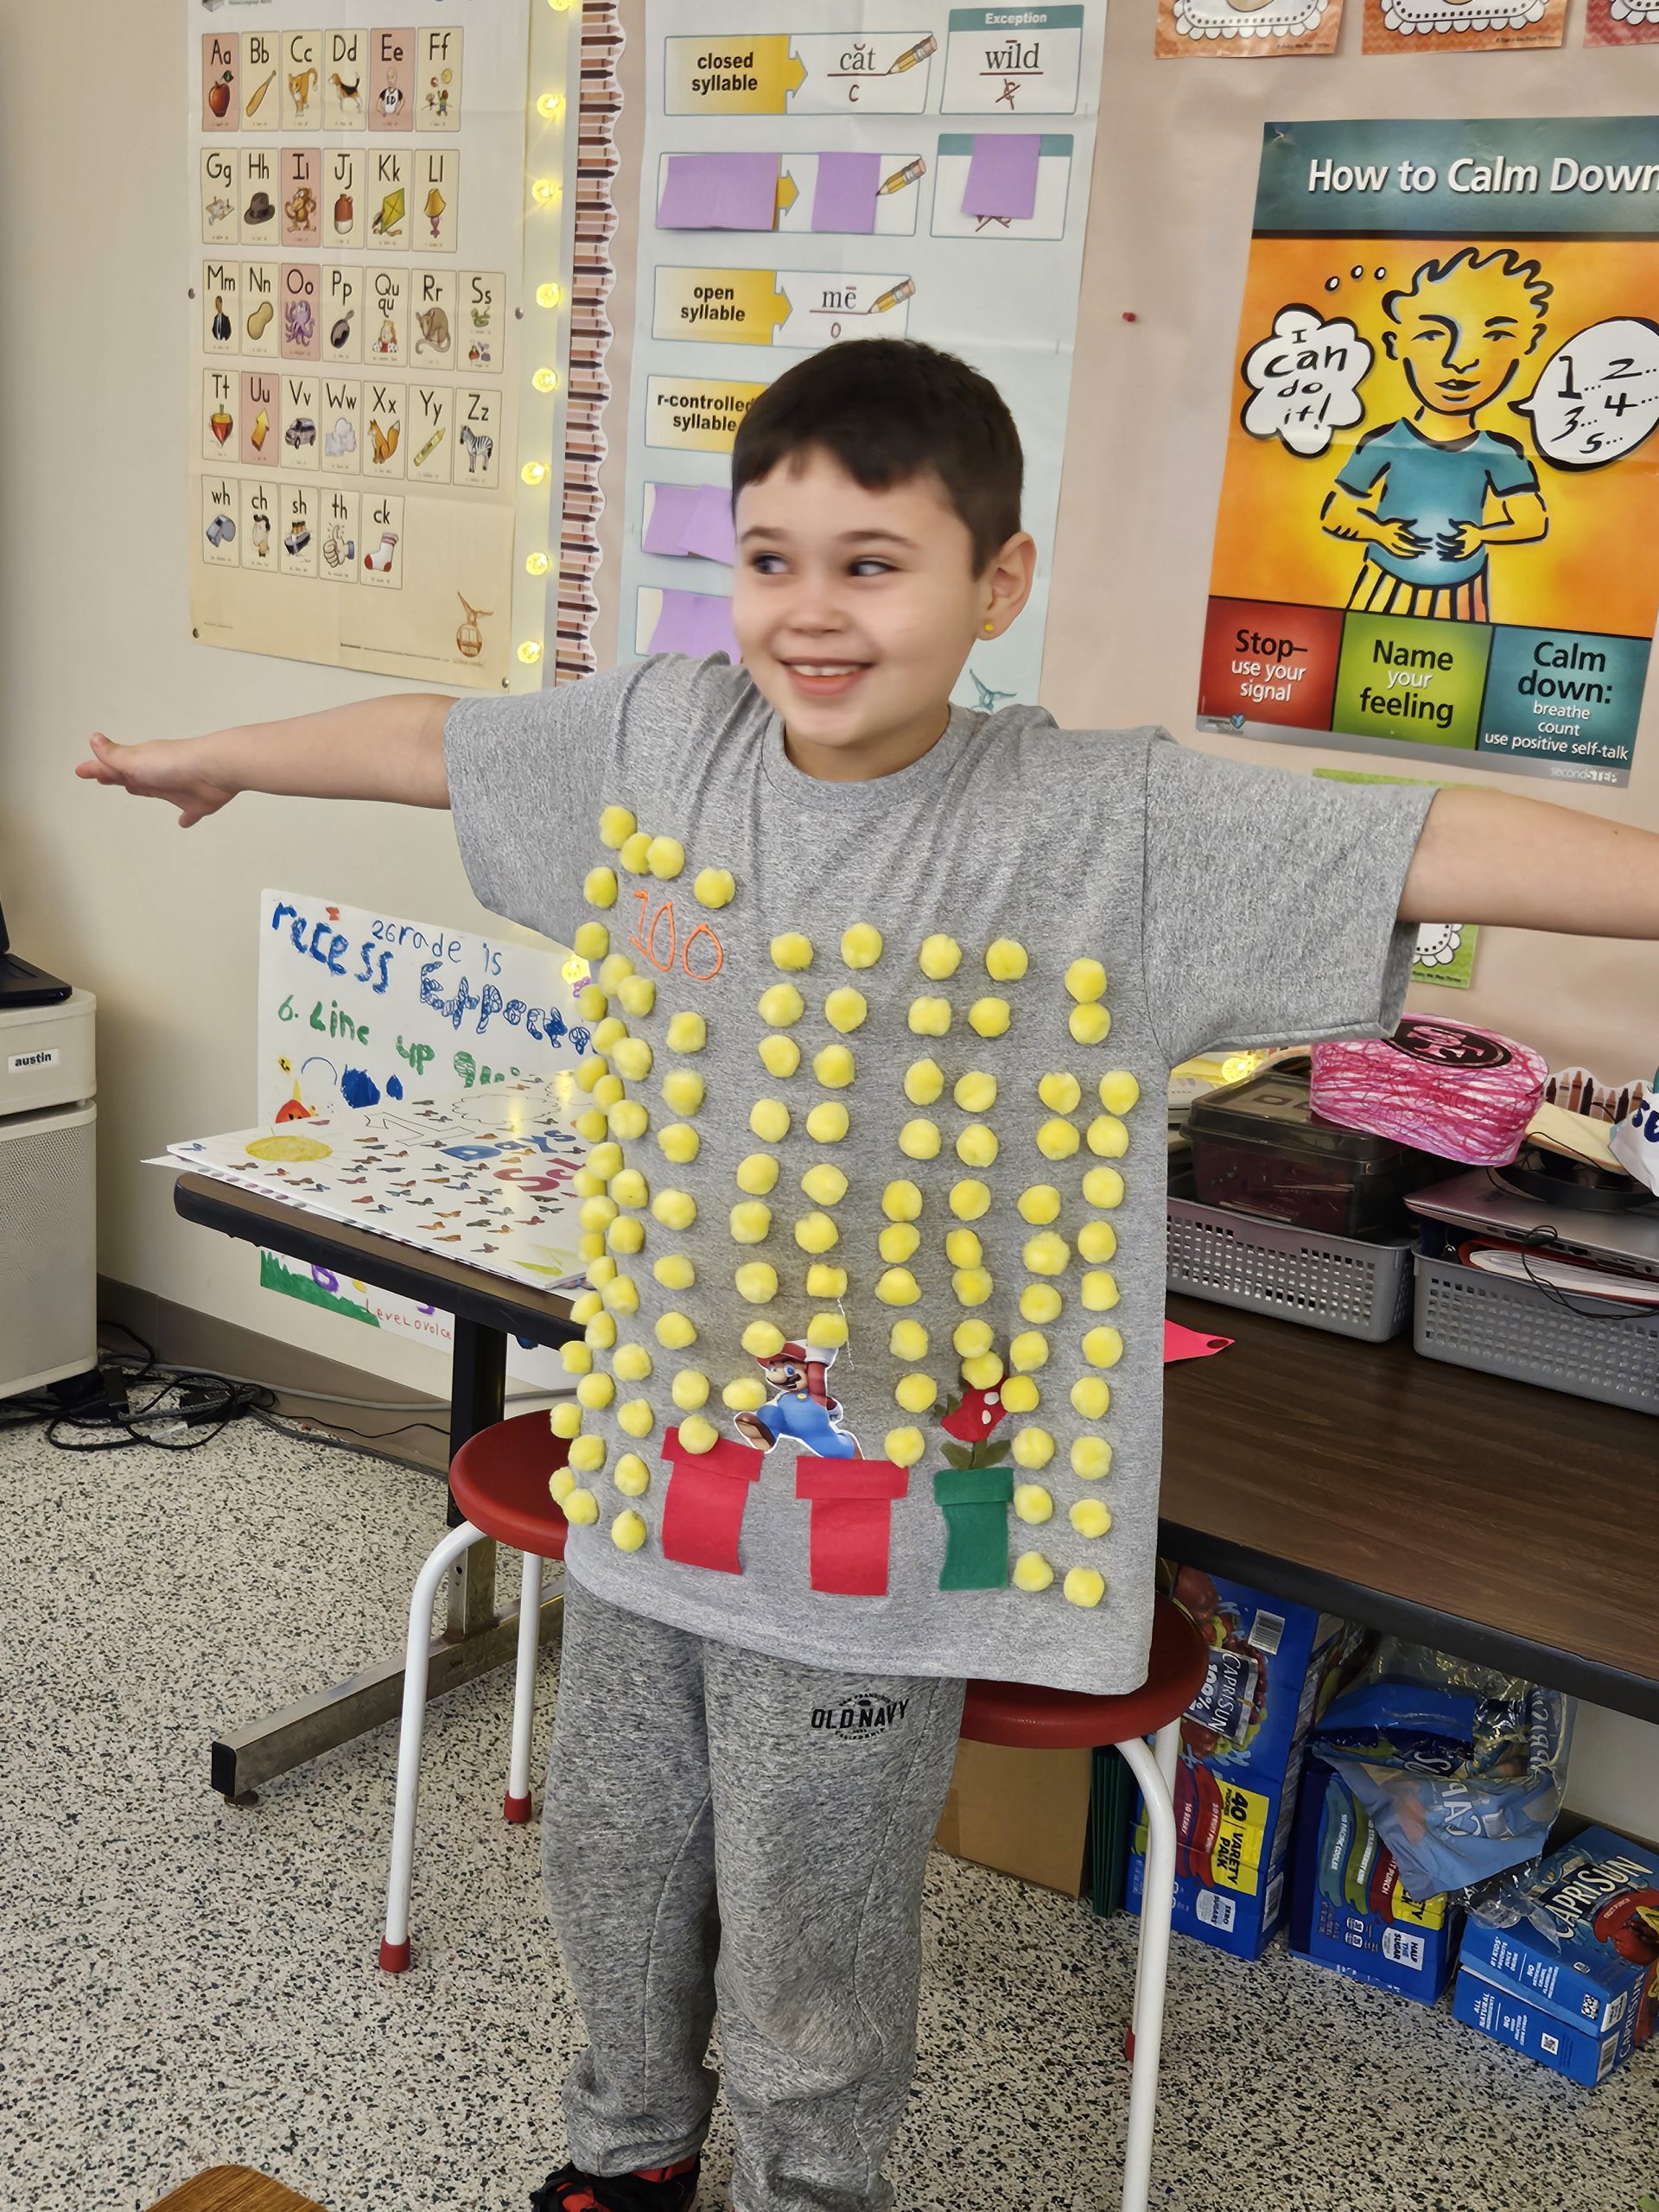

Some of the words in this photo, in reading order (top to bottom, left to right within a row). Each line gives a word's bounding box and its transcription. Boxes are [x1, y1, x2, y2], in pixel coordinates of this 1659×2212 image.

[985, 12, 1046, 25] Exception
[211, 39, 232, 66] Aa
[250, 38, 270, 64] Bb
[290, 35, 312, 62] Cc
[334, 35, 356, 62] Dd
[382, 35, 403, 61] Ee
[429, 33, 450, 60] Ff
[697, 52, 753, 69] closed
[691, 75, 758, 95] syllable
[207, 153, 232, 187] Gg
[249, 154, 270, 180] Hh
[293, 154, 308, 180] Ii
[335, 154, 353, 189] Jj
[378, 155, 399, 181] Kk
[1309, 158, 1388, 192] How
[1397, 161, 1435, 191] to
[1448, 156, 1538, 192] Calm
[207, 265, 235, 291] Mm
[250, 267, 270, 293] Nn
[287, 269, 314, 295] Oo
[333, 270, 352, 305] Pp
[423, 275, 442, 302] Rr
[472, 277, 492, 304] Ss
[693, 286, 734, 302] open
[681, 305, 746, 322] syllable
[1292, 330, 1306, 344] I
[1265, 346, 1346, 378] can
[212, 374, 229, 399] Tt
[251, 378, 270, 403] Uu
[289, 380, 310, 407] Vv
[327, 383, 356, 410] Ww
[373, 386, 396, 414] Xx
[420, 391, 442, 426] Yy
[468, 394, 488, 422] Zz
[1278, 379, 1323, 397] do
[673, 414, 737, 431] syllable
[1283, 393, 1331, 429] it!
[213, 481, 230, 505] wh
[251, 486, 267, 510] ch
[292, 491, 307, 514] sh
[332, 493, 347, 519] th
[373, 499, 390, 524] ck
[1373, 639, 1453, 671] Name
[1534, 641, 1606, 672] Calm
[1231, 660, 1261, 678] use
[1266, 663, 1306, 683] your
[1387, 670, 1432, 690] your
[1518, 669, 1613, 704] down:
[1240, 682, 1292, 703] signal
[1360, 687, 1453, 728] feeling
[1534, 700, 1591, 721] breathe
[1538, 720, 1580, 736] count
[1485, 731, 1508, 747] use
[1512, 735, 1567, 753] positive
[1571, 740, 1629, 761] self-talk
[272, 902, 394, 995] recess
[628, 889, 723, 980] 100
[16, 1052, 52, 1067] austin
[1197, 1664, 1218, 1712] 100%
[811, 1709, 854, 1729] OLD
[859, 1699, 909, 1727] NAVY
[1230, 1792, 1249, 1822] 40
[1544, 1855, 1654, 1938] CAPRISUN
[1527, 1964, 1535, 1977] NO
[1479, 1993, 1490, 2027] NATURAL
[1503, 2015, 1510, 2028] NO
